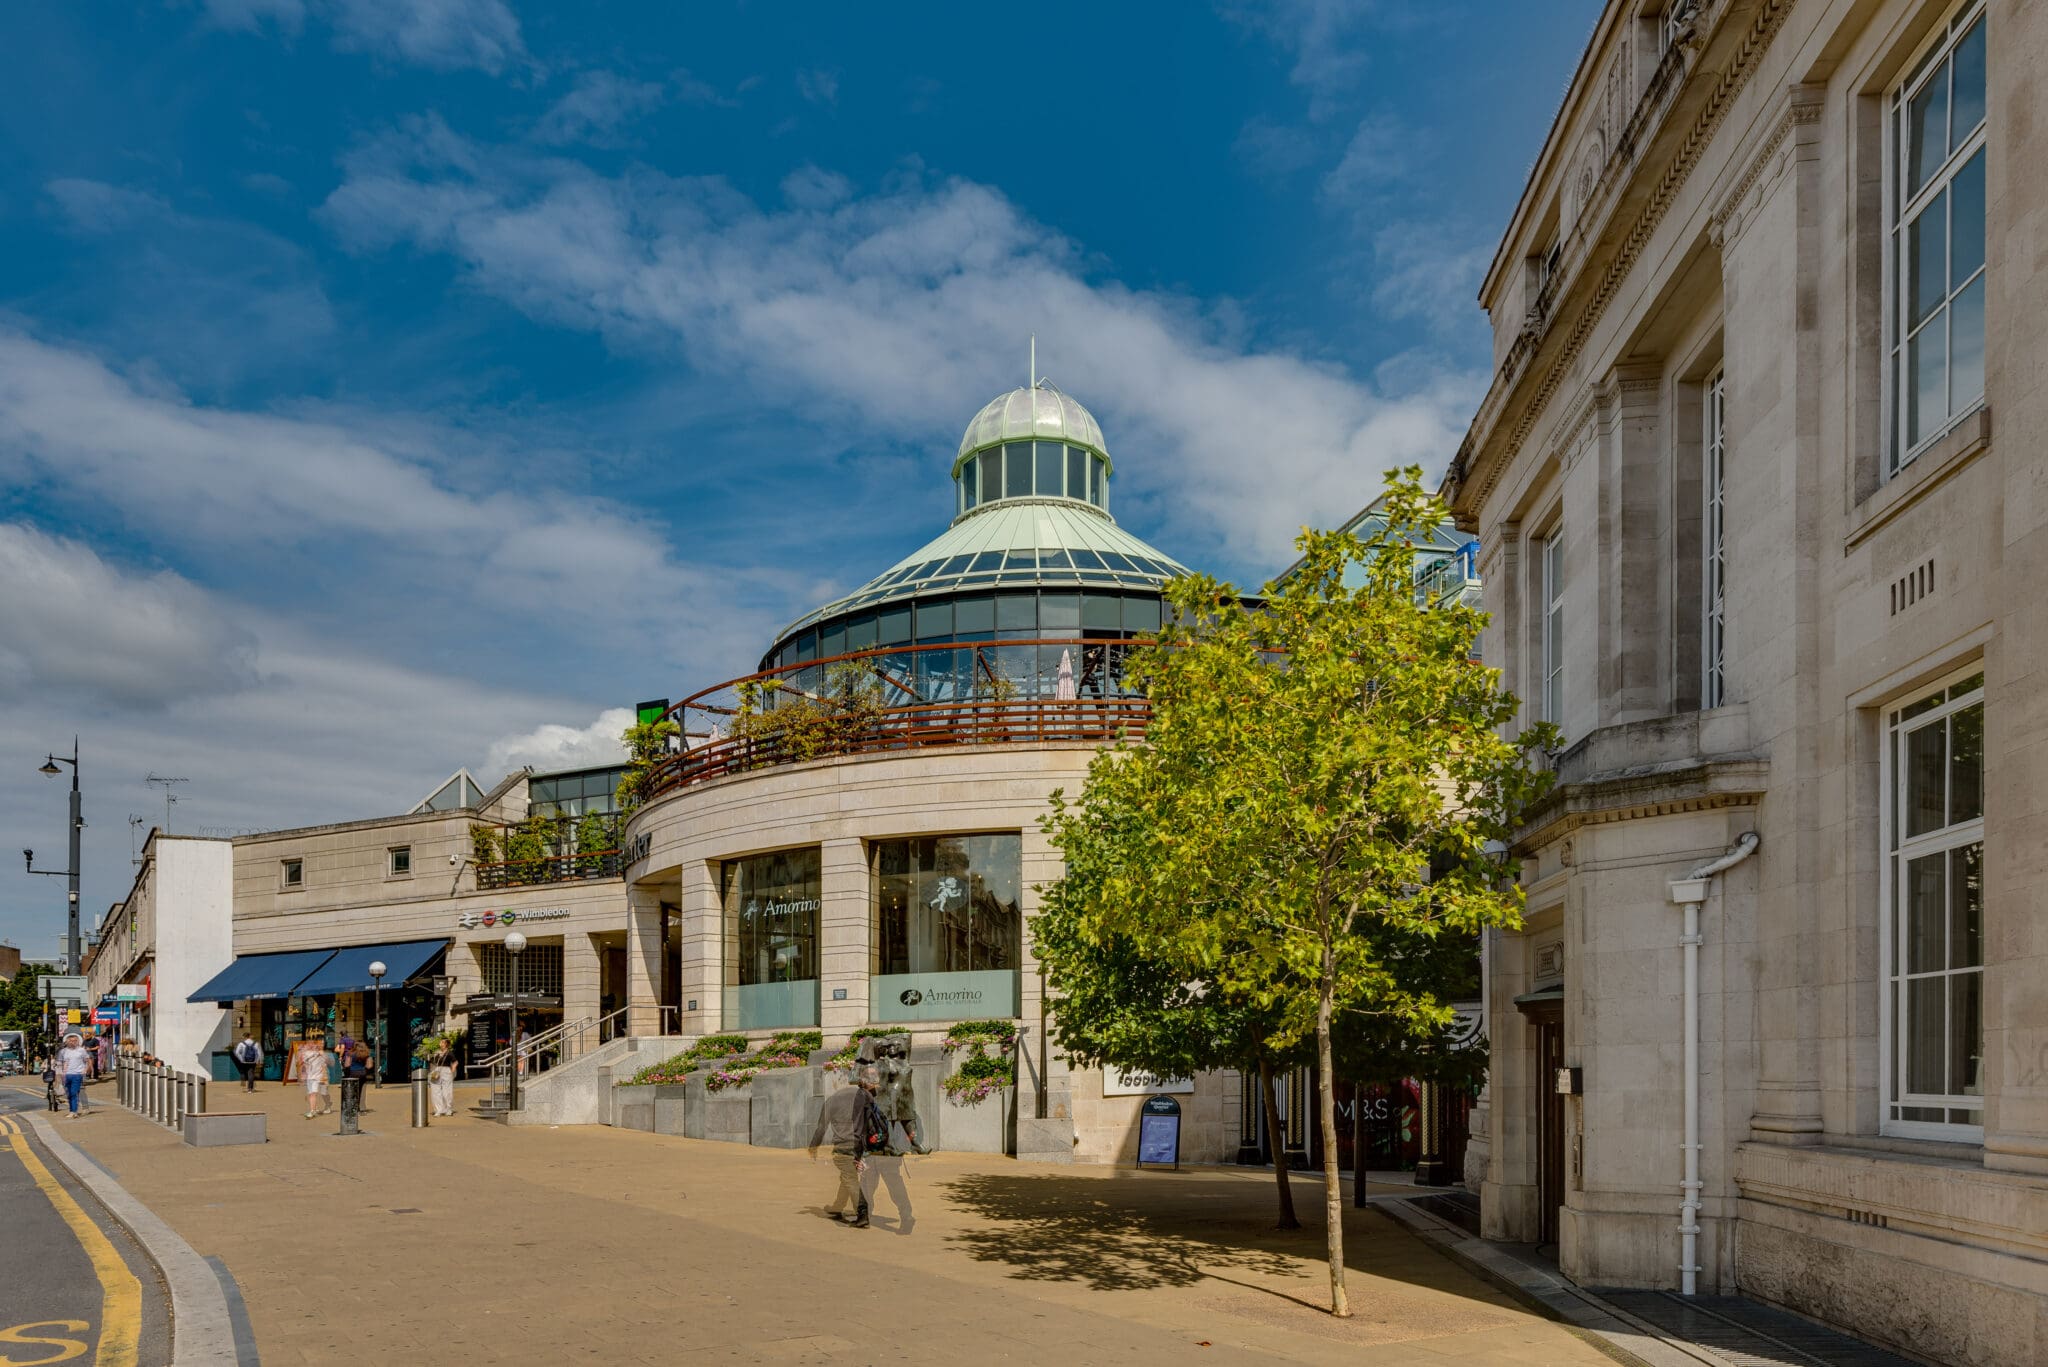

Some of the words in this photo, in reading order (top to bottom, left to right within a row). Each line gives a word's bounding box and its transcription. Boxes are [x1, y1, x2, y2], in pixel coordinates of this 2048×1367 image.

[520, 907, 570, 920] Wimbledon
[763, 897, 821, 917] Amorino
[924, 987, 983, 1002] Amorino
[1337, 1098, 1388, 1121] M&S
